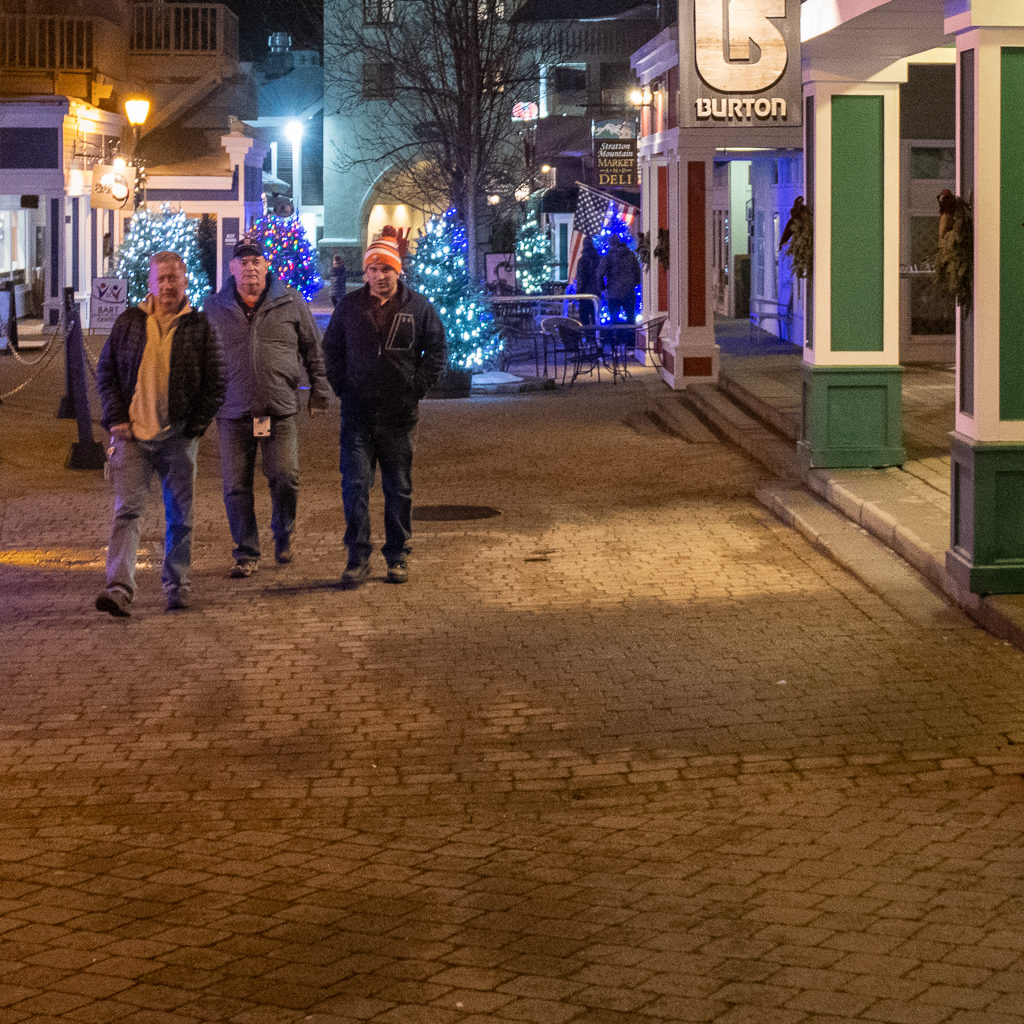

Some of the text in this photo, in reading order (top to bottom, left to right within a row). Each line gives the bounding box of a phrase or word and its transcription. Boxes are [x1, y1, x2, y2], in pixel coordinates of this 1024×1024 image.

[695, 97, 787, 119] BURTON
[600, 142, 631, 151] Stratton
[597, 150, 634, 158] Mountain
[598, 158, 635, 167] MARKET
[599, 174, 632, 185] DELI
[97, 306, 119, 314] BART
